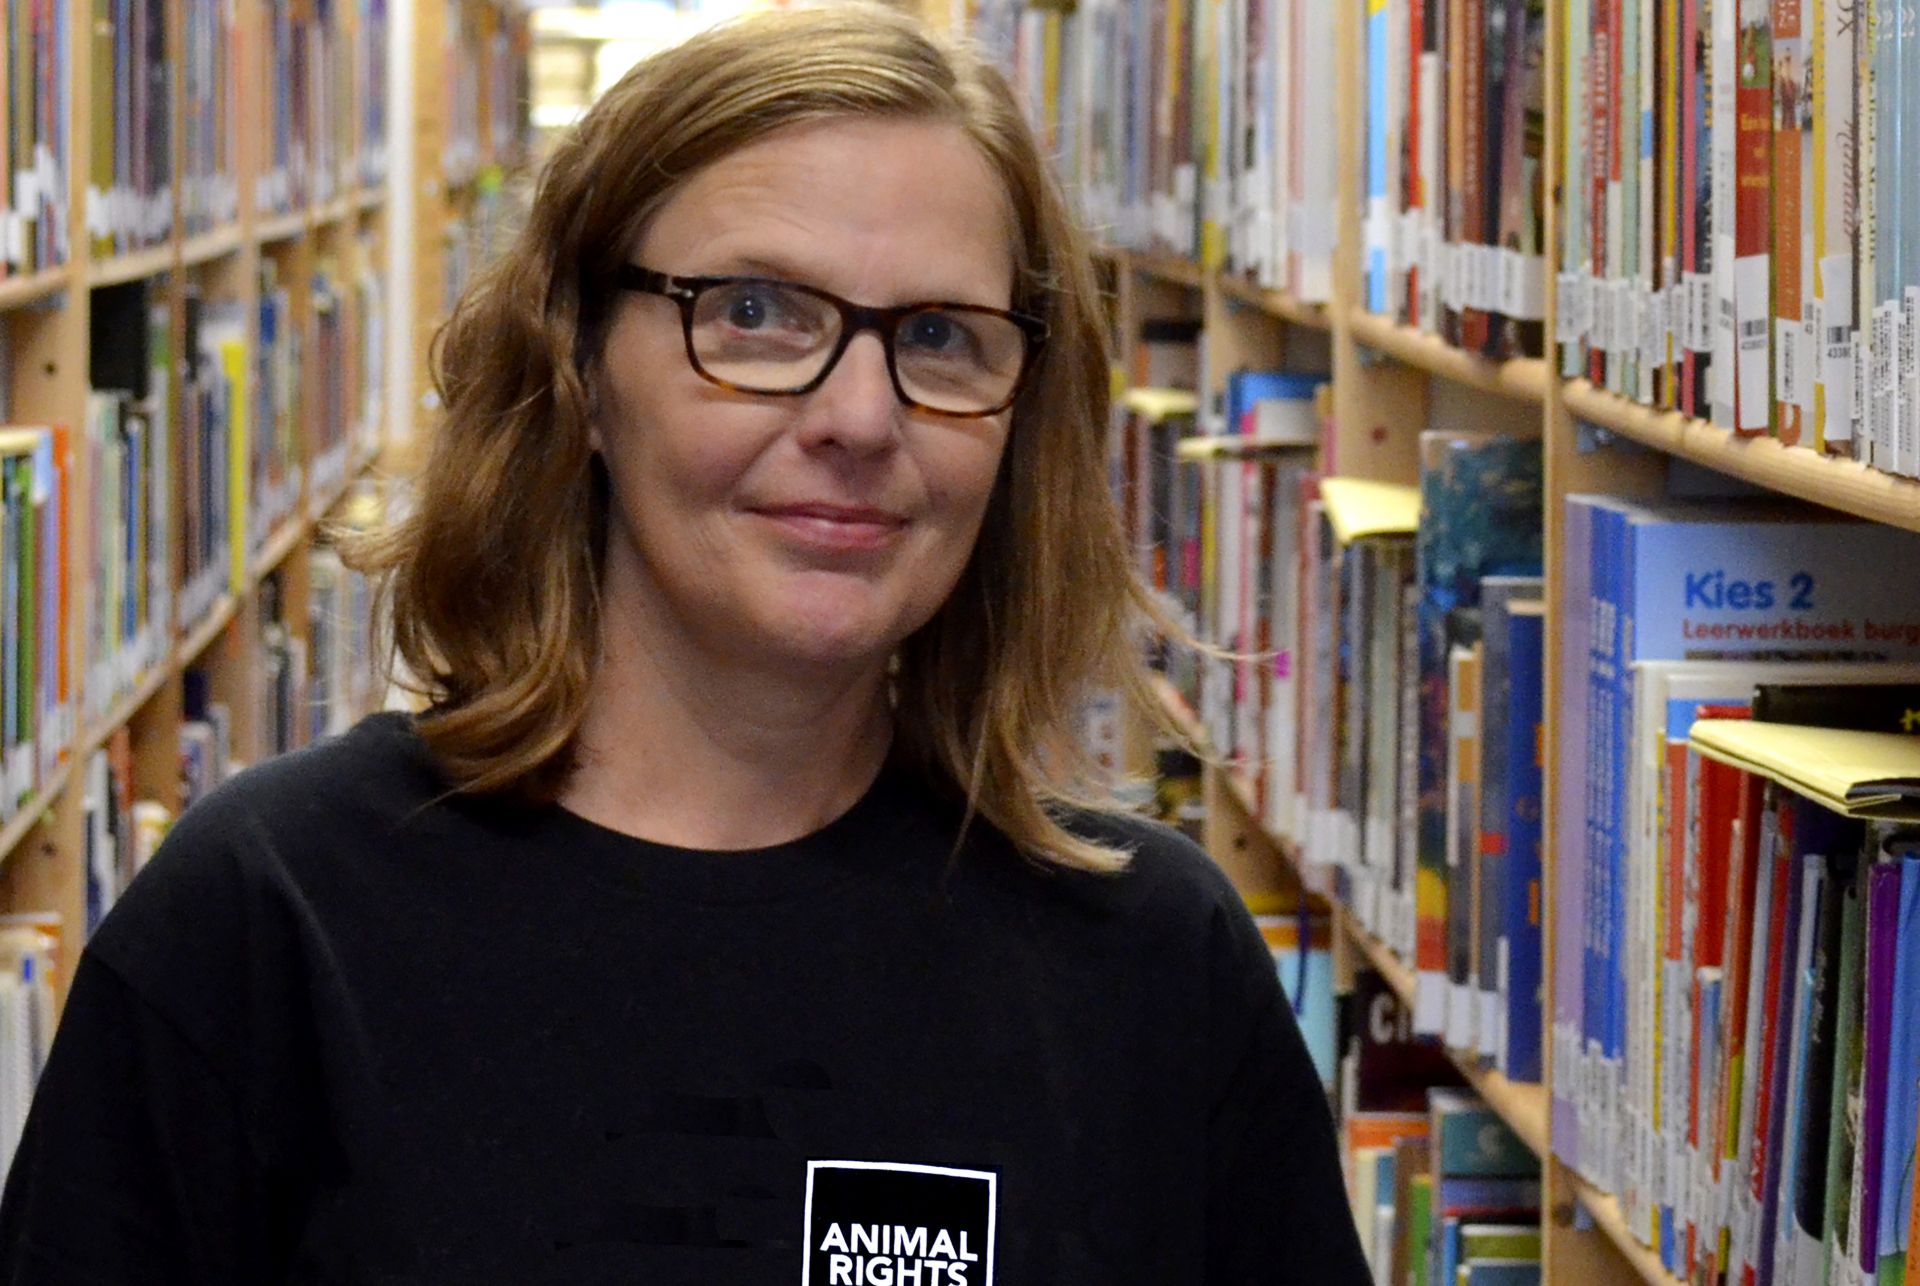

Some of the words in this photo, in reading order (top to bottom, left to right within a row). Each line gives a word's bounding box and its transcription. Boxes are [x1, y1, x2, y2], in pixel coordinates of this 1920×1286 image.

[1684, 569, 1775, 610] Kies
[1788, 571, 1815, 610] 2
[1682, 617, 1854, 640] Leerwerkboek
[819, 1222, 979, 1262] ANIMAL
[830, 1254, 968, 1286] RIGHTS
